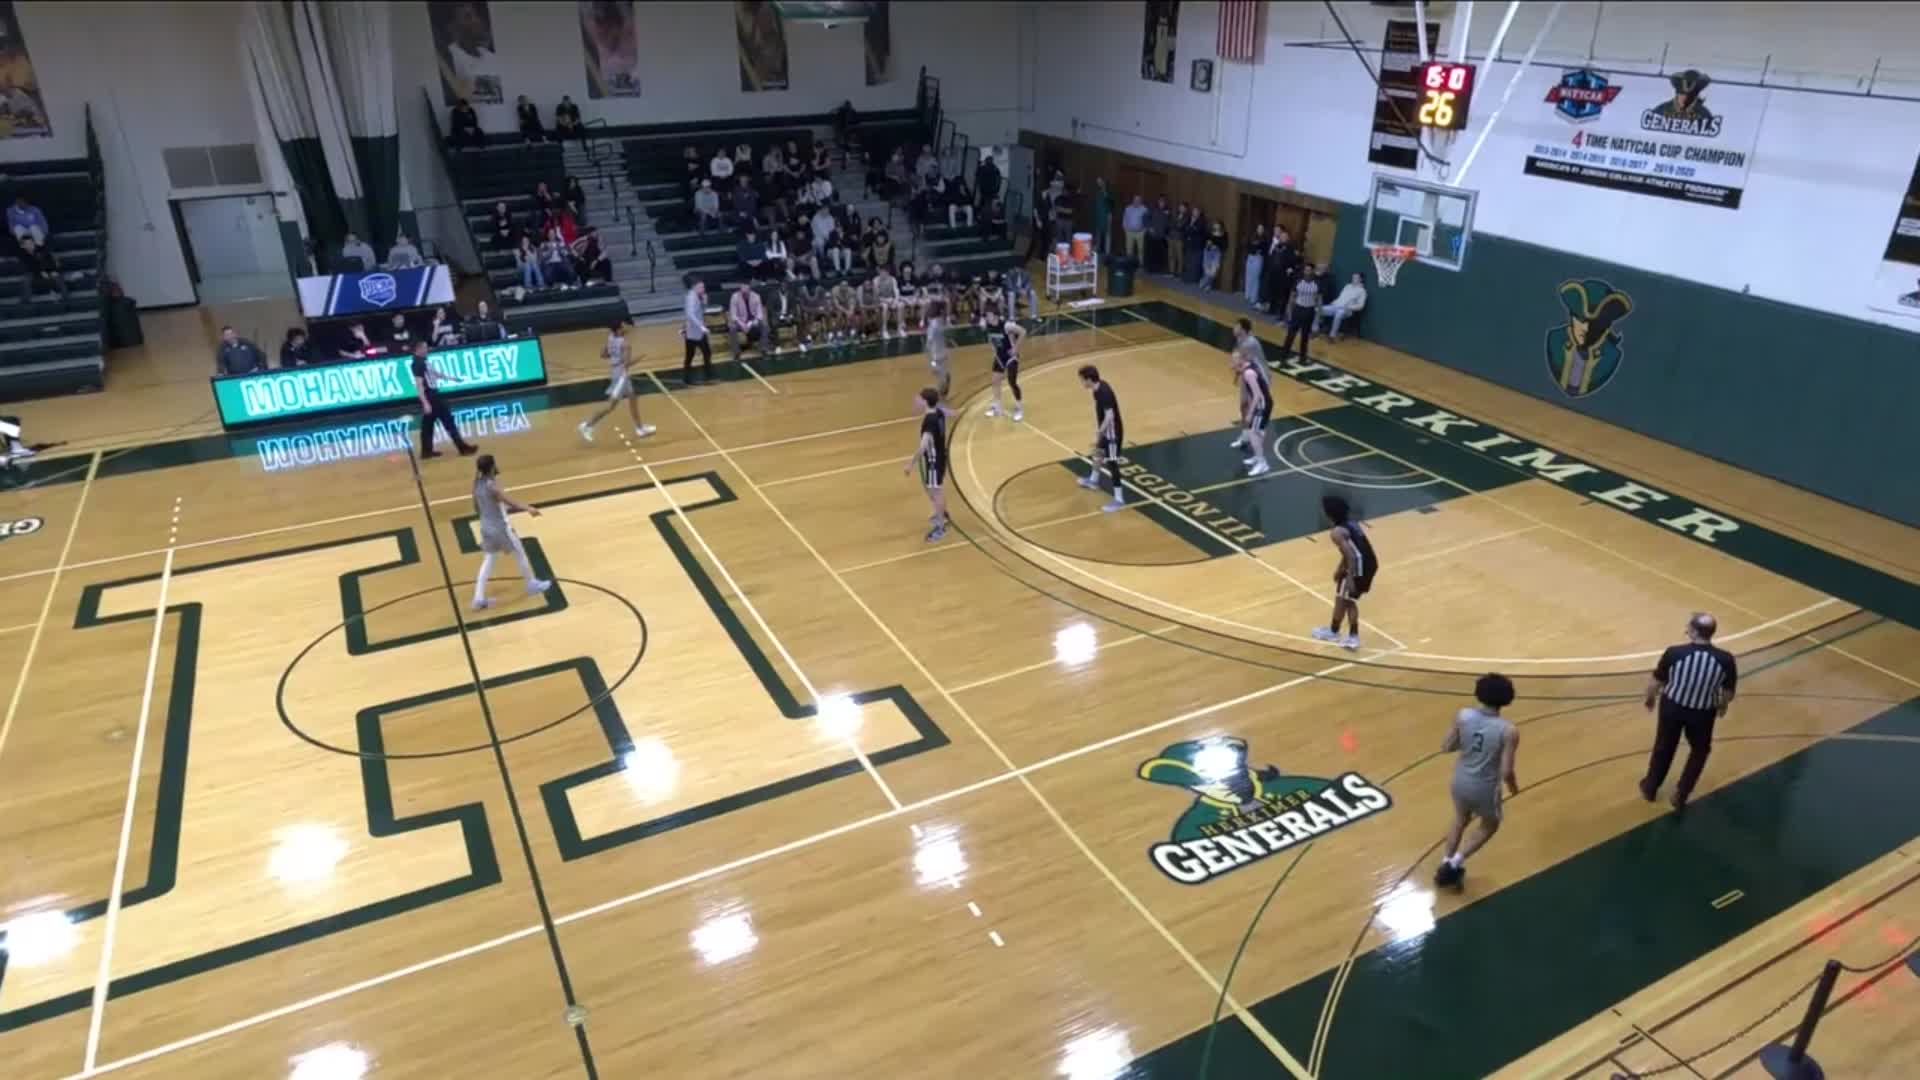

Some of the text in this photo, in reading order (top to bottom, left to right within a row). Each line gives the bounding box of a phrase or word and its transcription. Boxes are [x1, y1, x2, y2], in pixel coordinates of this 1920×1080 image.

[1419, 90, 1455, 126] 26
[1560, 87, 1603, 101] NATYCAA
[1642, 110, 1722, 136] GENERALS
[1571, 130, 1745, 168] 4 TIME NATYCAA CUP CHAMPION
[240, 361, 403, 416] MOHAWK
[1267, 356, 1741, 543] HERKIMER
[1472, 730, 1485, 753] 3
[1152, 773, 1389, 883] GENERALS
[1199, 789, 1312, 837] HERKIMER
